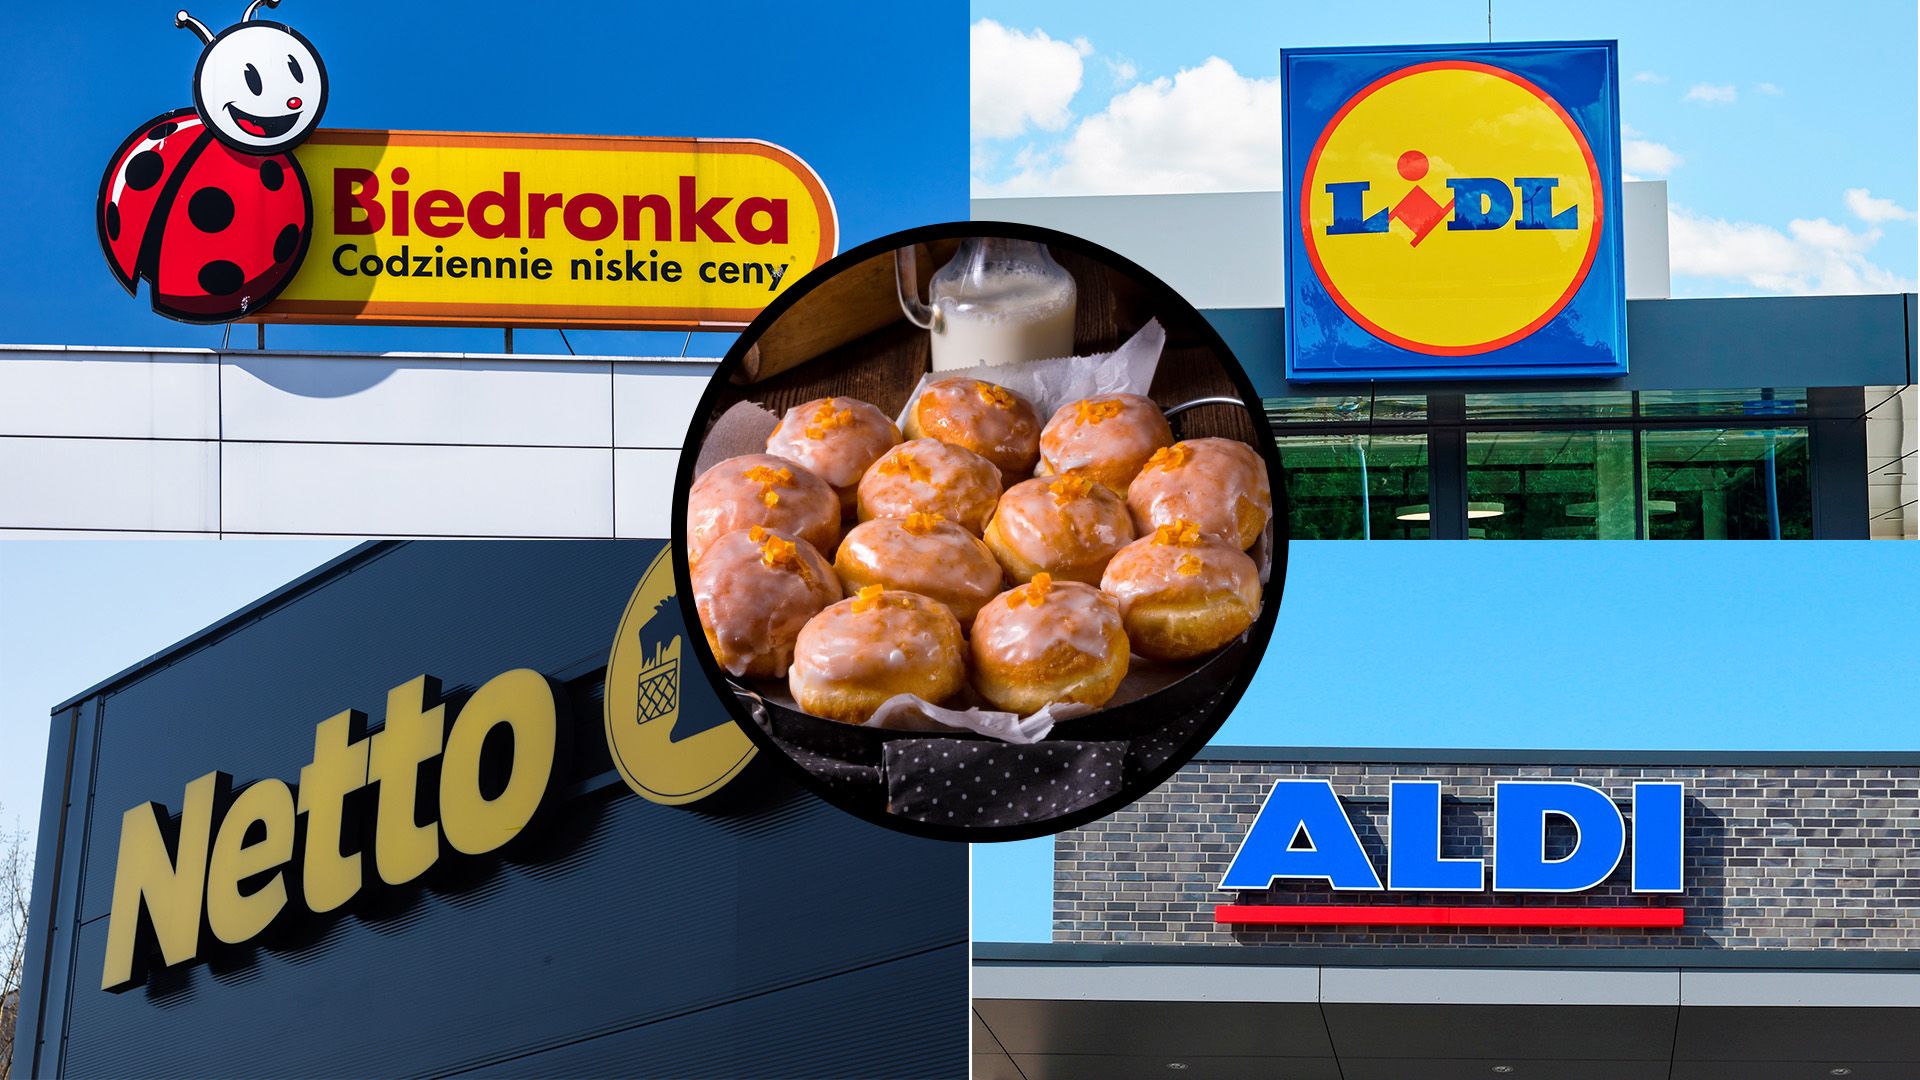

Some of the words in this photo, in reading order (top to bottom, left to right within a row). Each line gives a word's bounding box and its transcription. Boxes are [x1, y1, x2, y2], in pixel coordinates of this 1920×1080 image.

[333, 167, 789, 244] Biedronka
[332, 244, 553, 279] Codziennie
[570, 248, 682, 283] niskie
[699, 260, 789, 291] ceny
[102, 668, 557, 992] Netto
[1217, 779, 1685, 893] ALDI
